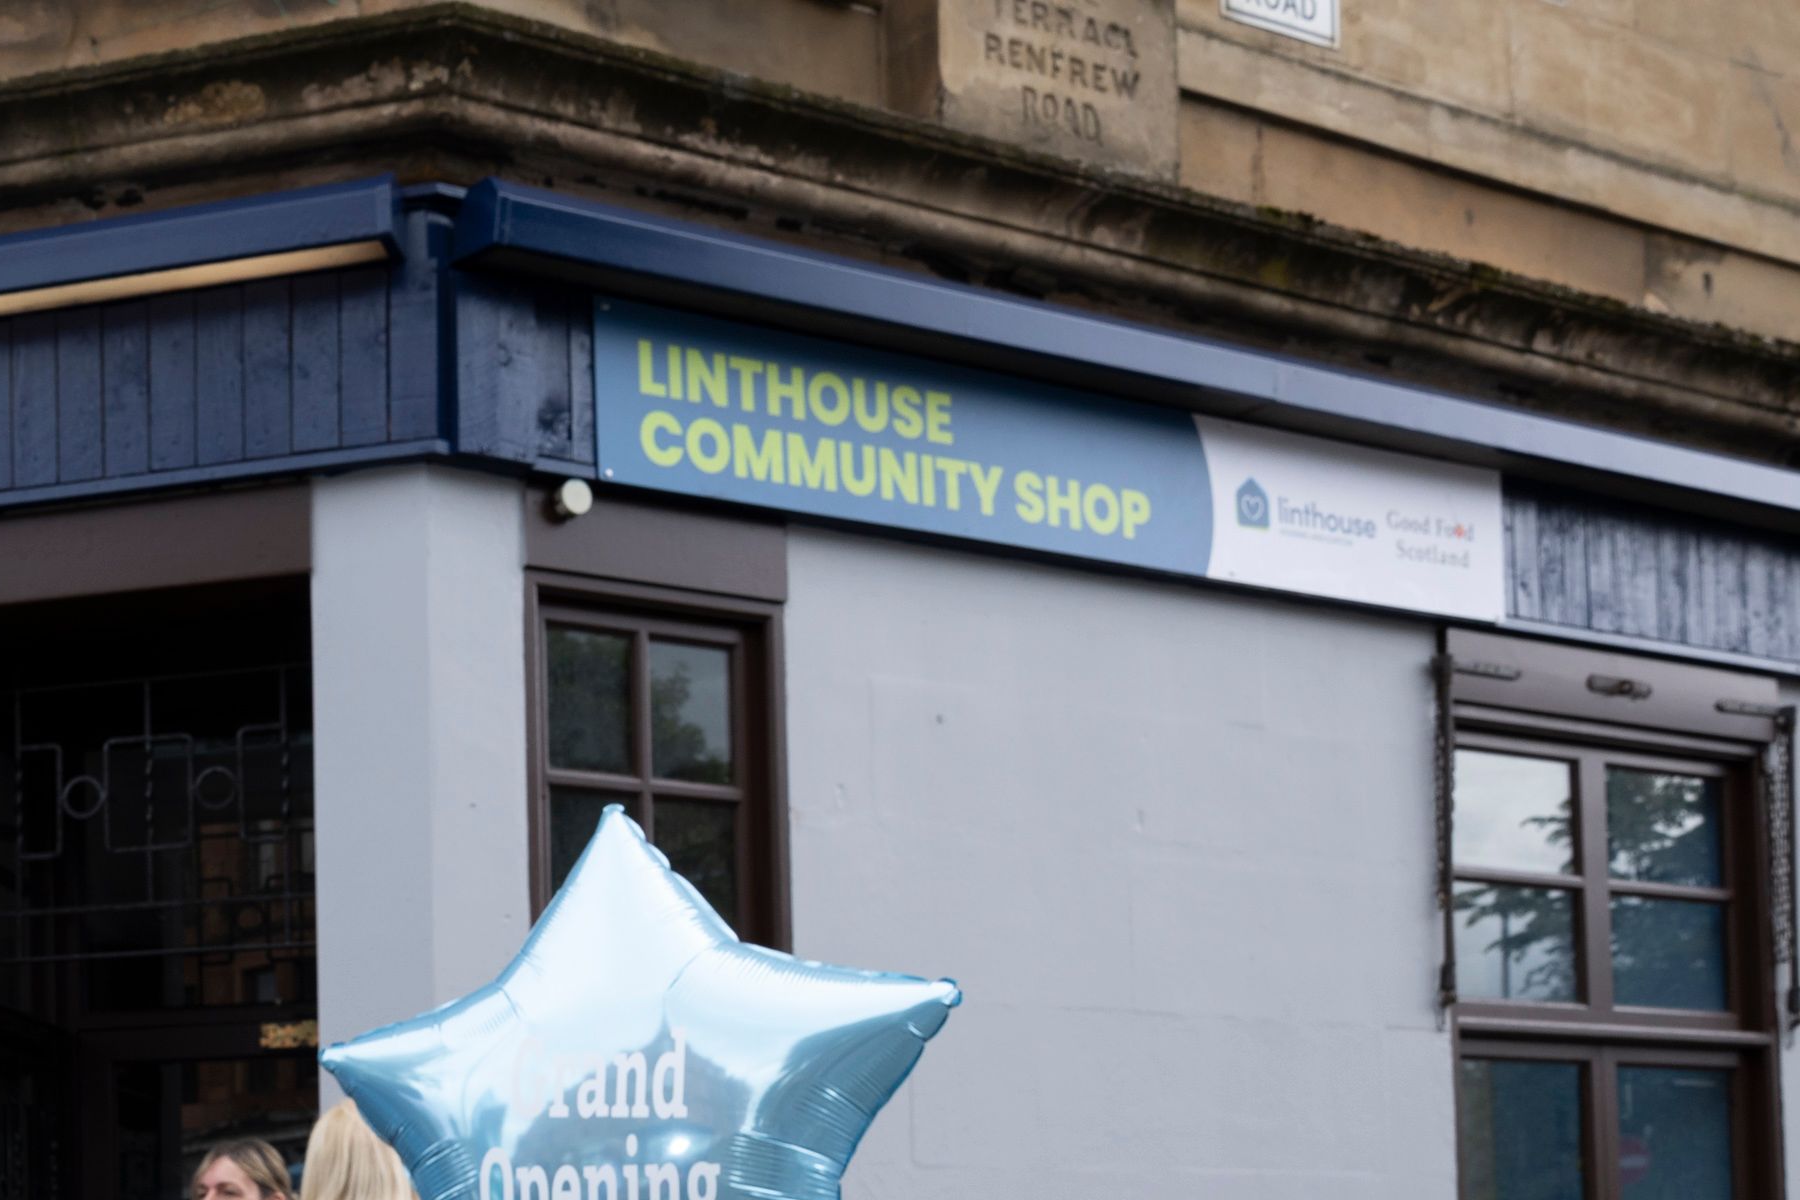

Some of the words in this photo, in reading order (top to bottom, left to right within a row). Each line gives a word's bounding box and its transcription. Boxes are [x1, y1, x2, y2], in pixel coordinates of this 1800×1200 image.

[983, 33, 1142, 98] RENFREW
[1020, 85, 1103, 146] ROAD
[636, 340, 954, 445] LINTHOUSE
[638, 411, 1003, 517] COMMUNITY
[1014, 470, 1152, 540] SHOP
[1277, 496, 1377, 538] linthouse
[1385, 509, 1430, 535] Good
[1395, 538, 1471, 569] Scotland
[512, 1026, 689, 1120] Grand
